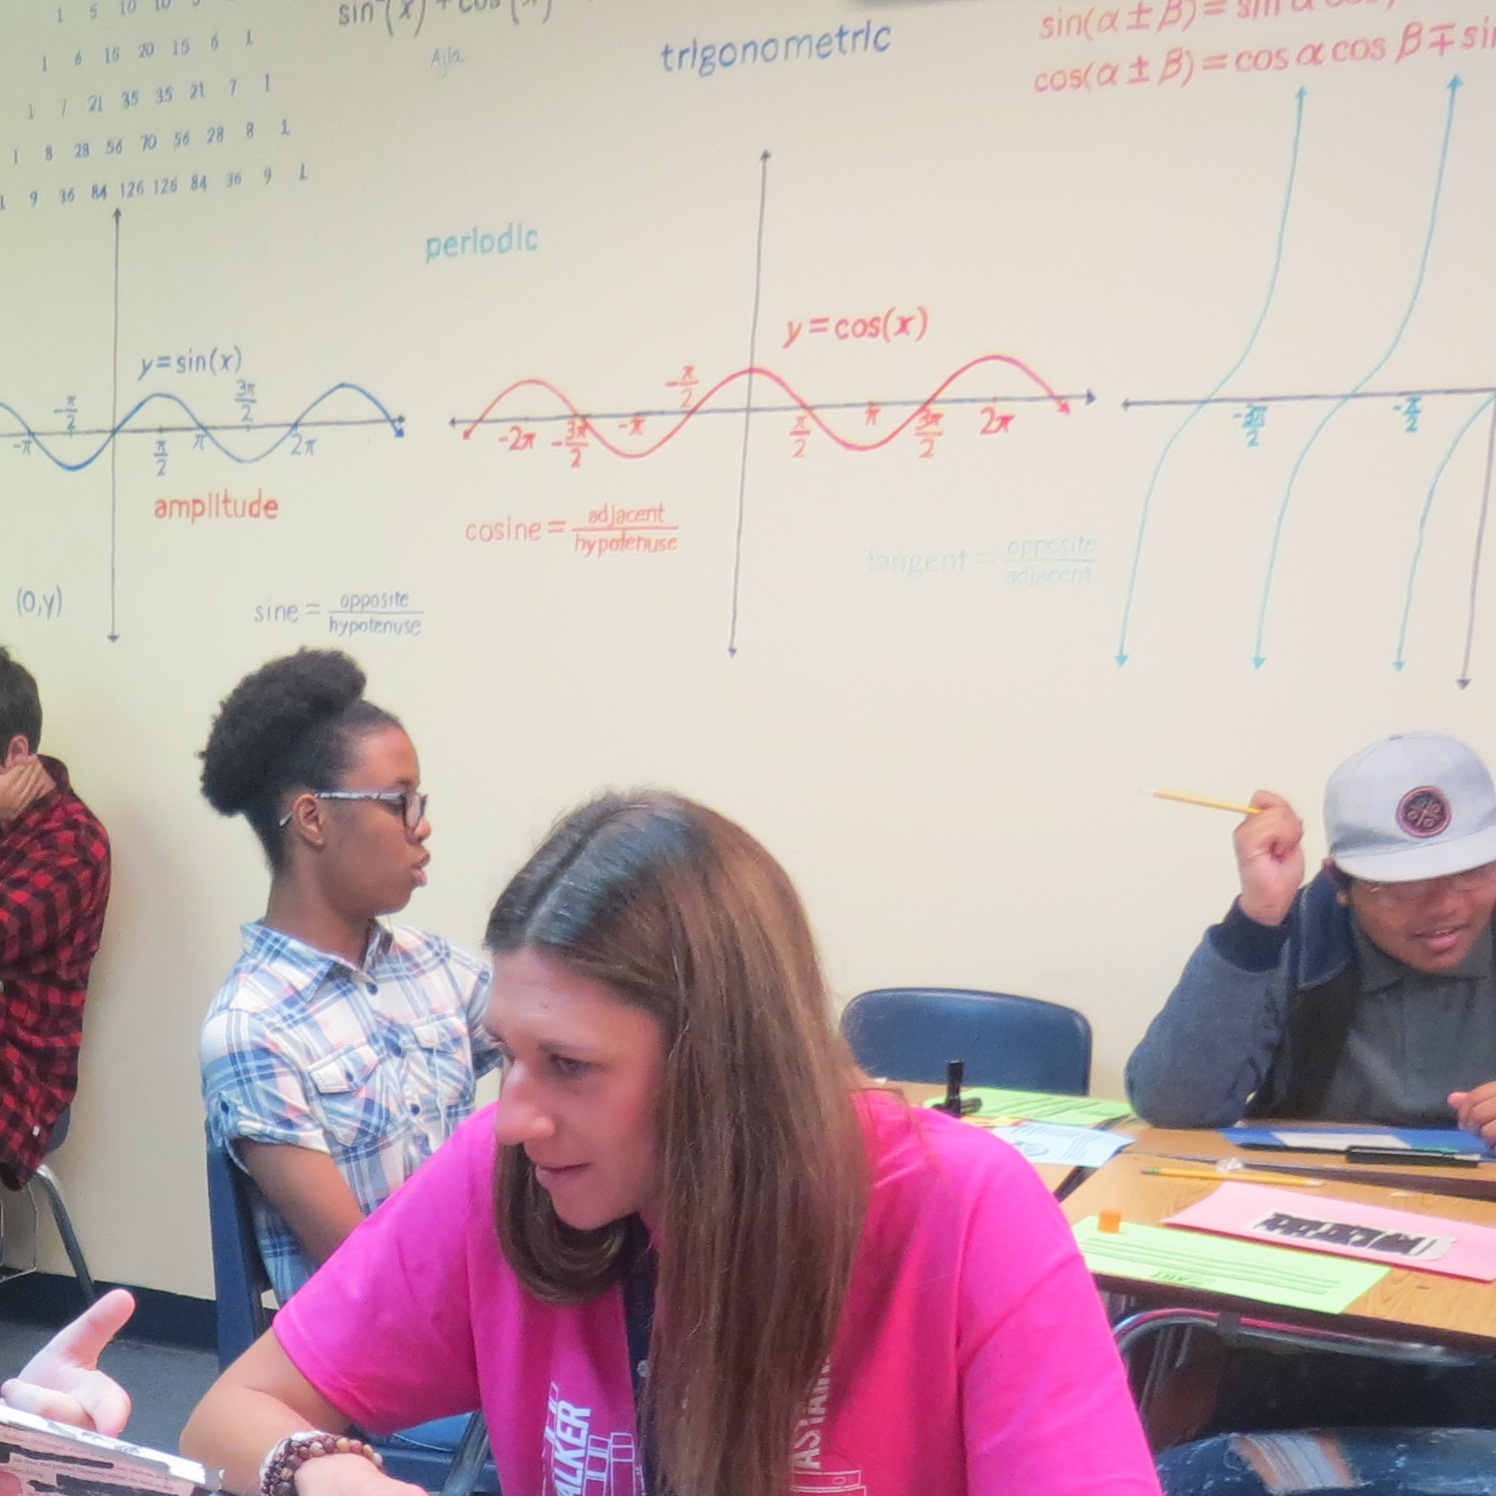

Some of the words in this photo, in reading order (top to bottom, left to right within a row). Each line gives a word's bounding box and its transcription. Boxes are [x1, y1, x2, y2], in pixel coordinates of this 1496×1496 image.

[120, 0, 138, 15] 10
[104, 46, 121, 64] 15
[138, 41, 155, 58] 20
[172, 37, 191, 56] 15
[660, 21, 893, 77] trigonometric
[88, 95, 103, 113] 21
[121, 90, 140, 109] 35
[155, 86, 174, 105] 35
[190, 81, 205, 99] 21
[74, 142, 90, 159] 28
[104, 138, 123, 156] 56
[140, 134, 157, 151] 70
[173, 130, 190, 149] 56
[207, 125, 224, 145] 28
[59, 187, 75, 203] 36
[91, 184, 107, 201] 84
[120, 180, 144, 199] 126
[154, 177, 178, 195] 126
[191, 174, 207, 193] 84
[226, 171, 242, 188] 36
[425, 223, 540, 264] periodic
[154, 489, 279, 522] amplitude
[587, 502, 665, 528] adjacent
[465, 515, 543, 543] cosine
[573, 531, 678, 558] hypotenuse
[866, 548, 968, 579] tangent
[16, 587, 63, 617] (0,y)
[254, 598, 300, 624] sine
[339, 589, 410, 612] opposite
[328, 614, 423, 638] hypotenuse
